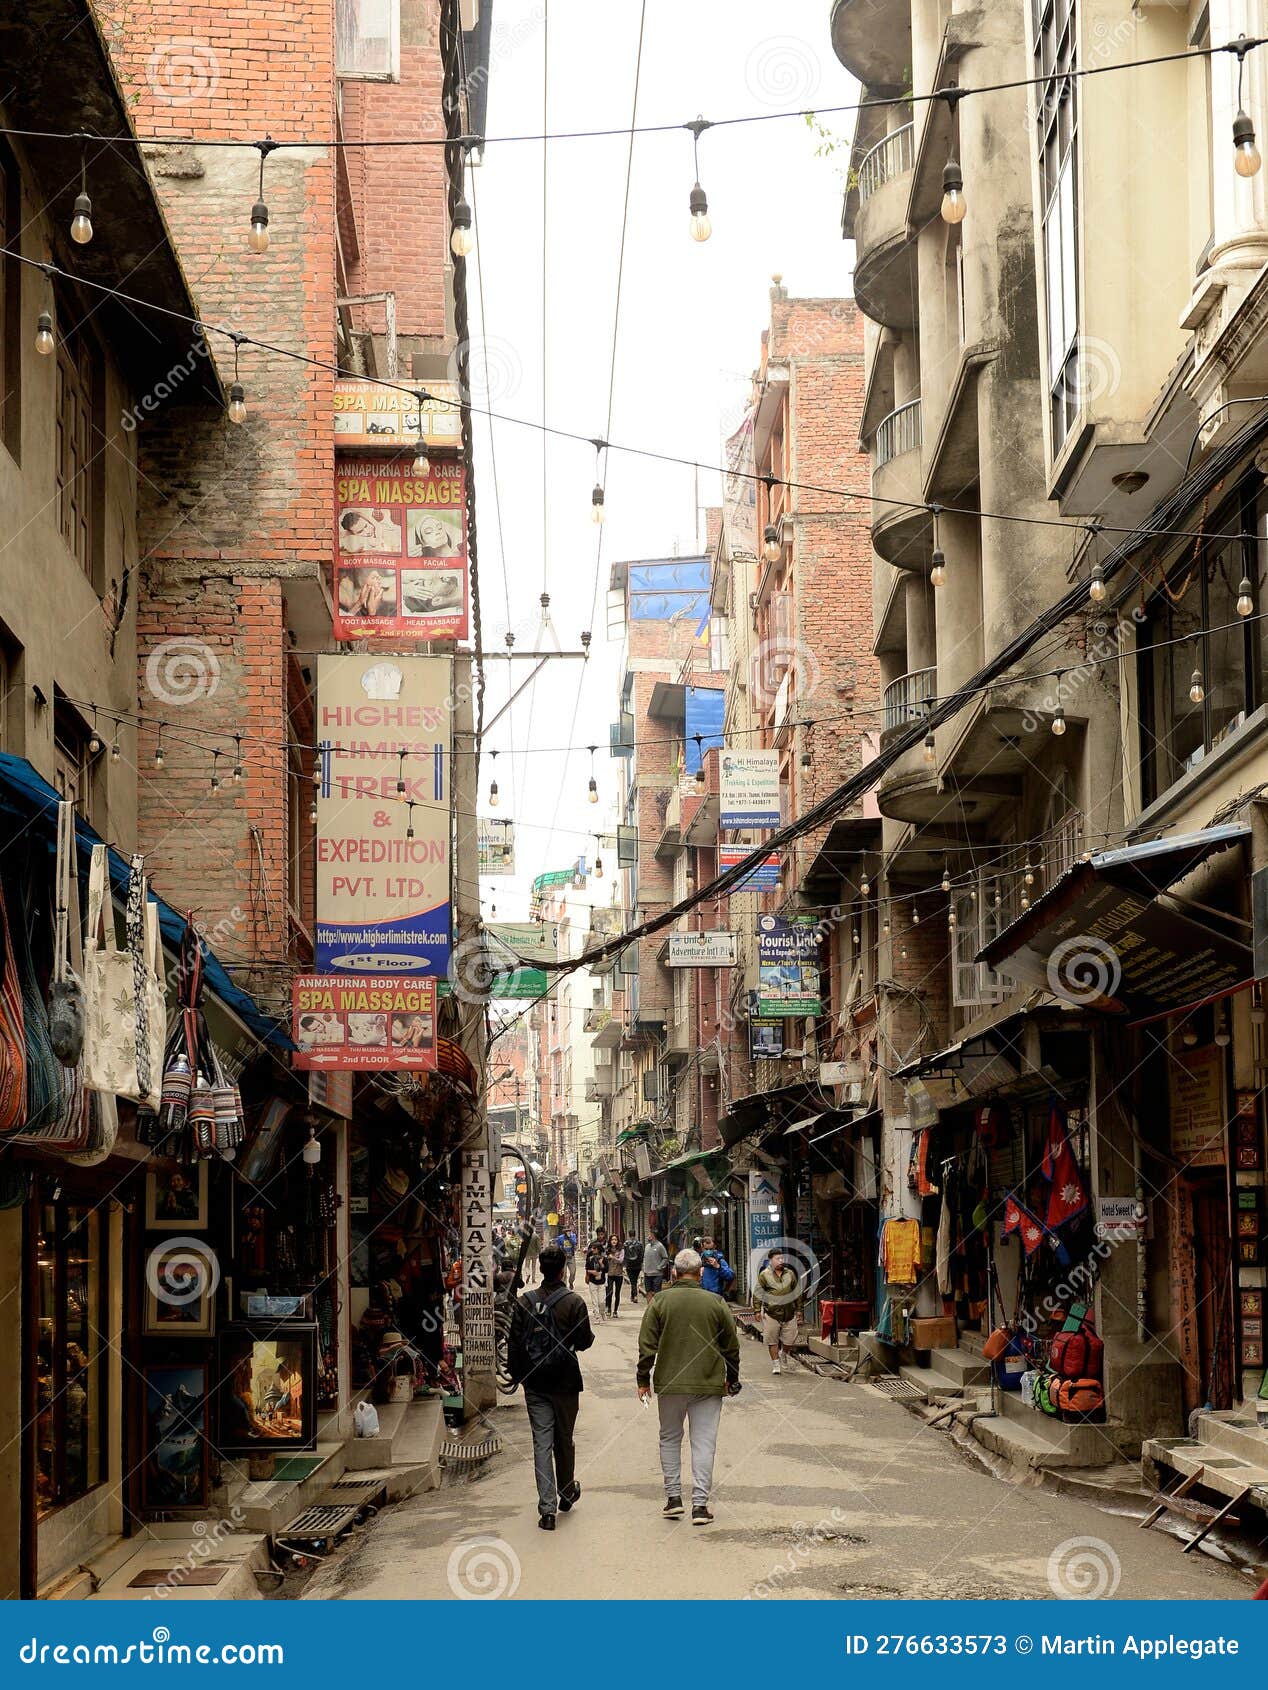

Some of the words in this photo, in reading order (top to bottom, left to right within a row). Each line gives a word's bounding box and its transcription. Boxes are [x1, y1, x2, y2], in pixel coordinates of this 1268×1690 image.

[334, 395, 368, 411] SPA
[372, 395, 461, 413] MASSAGE
[337, 463, 400, 478] ANNAPURNA
[434, 464, 461, 478] CARE
[338, 480, 371, 503] SPA
[376, 480, 461, 504] MASSAGE
[343, 558, 361, 566] BODY
[423, 559, 448, 567] FACIAL
[427, 618, 460, 626] MASSAGE
[322, 706, 444, 727] HIGHER
[335, 741, 431, 762] LIMITS
[737, 758, 745, 766] Hi
[746, 757, 778, 767] Himalaya
[335, 775, 428, 801] TREK
[372, 810, 392, 828] &
[318, 838, 446, 865] EXPEDITION
[332, 877, 377, 897] PVT.
[385, 877, 432, 899] LTD.
[317, 928, 447, 947] http://www.higherlimitstrek.com
[760, 933, 795, 947] Tourist
[796, 932, 818, 947] Link
[671, 946, 705, 956] Adventure
[347, 956, 372, 966] 1st
[377, 959, 415, 967] Floor
[299, 978, 367, 989] ANNAPURNA
[370, 979, 400, 989] BODY
[403, 980, 433, 990] CARE
[299, 991, 335, 1012] SPA
[340, 991, 432, 1012] MASSAGE
[1101, 1203, 1114, 1216] Hotel
[1115, 1203, 1131, 1216] Sweet
[464, 1153, 488, 1290] HIMALAYAN
[754, 1226, 778, 1235] SALE
[464, 1292, 492, 1306] HONEY
[464, 1307, 494, 1321] SUPPLIERS
[464, 1340, 493, 1352] THAMEL
